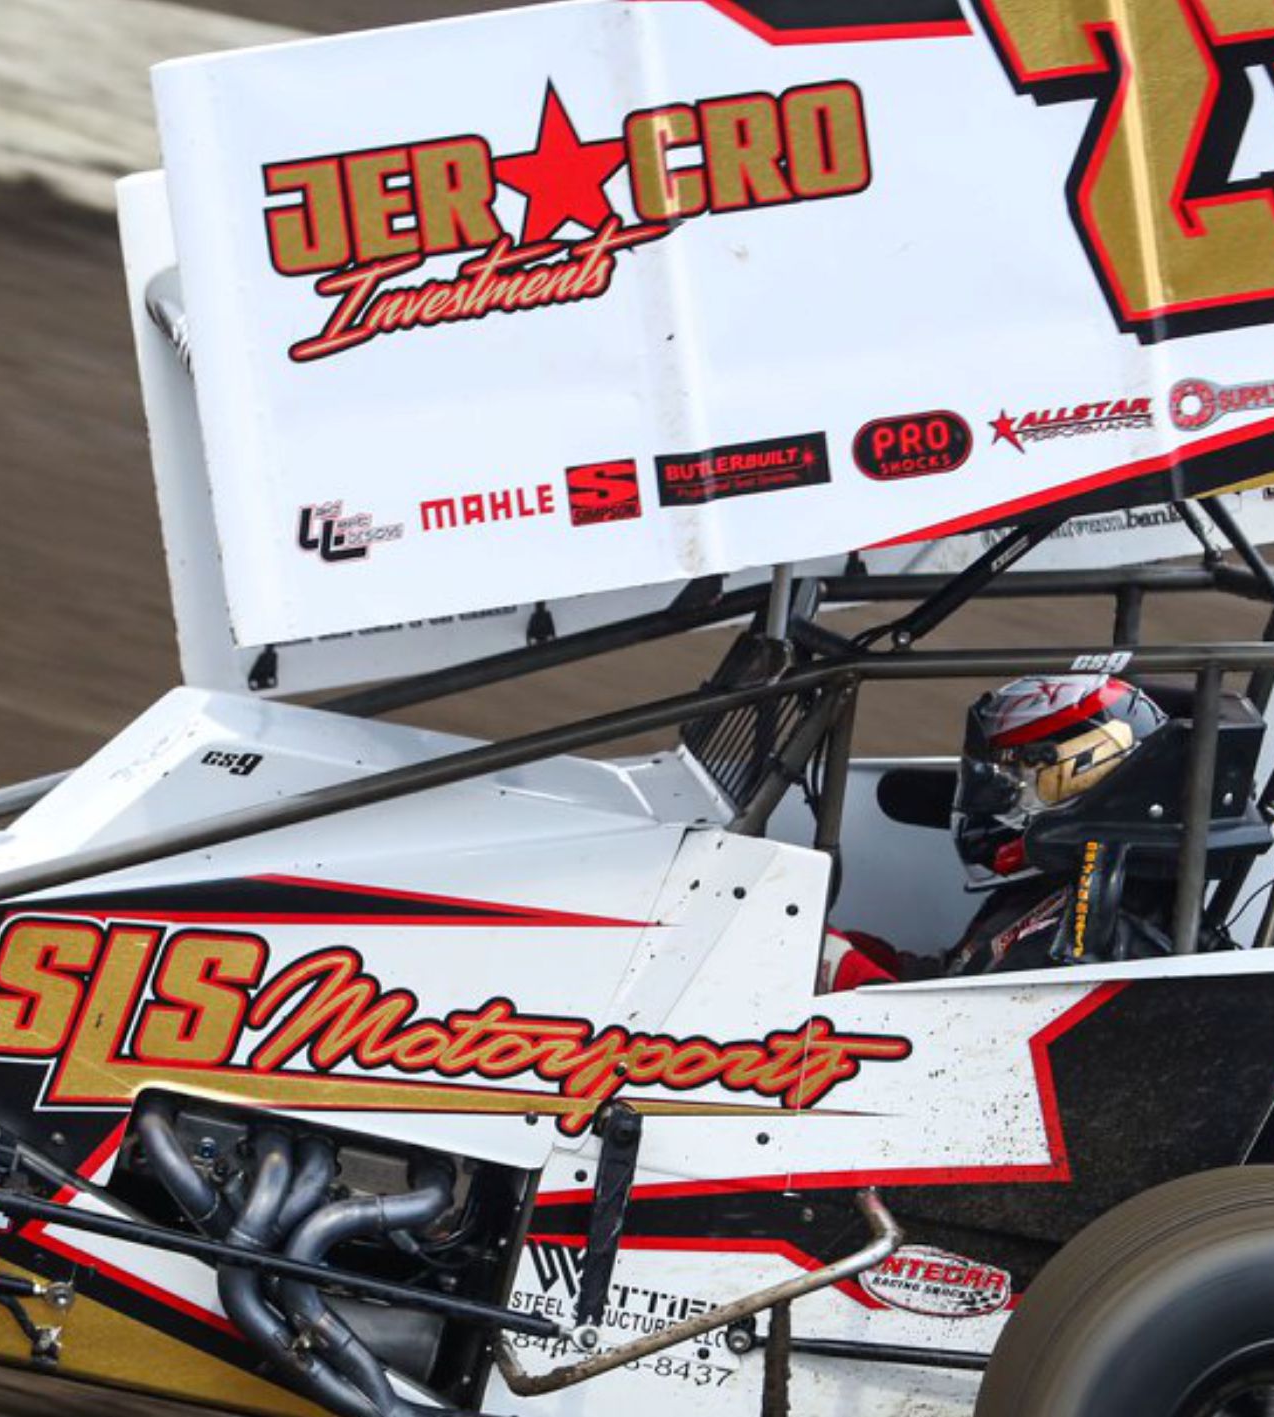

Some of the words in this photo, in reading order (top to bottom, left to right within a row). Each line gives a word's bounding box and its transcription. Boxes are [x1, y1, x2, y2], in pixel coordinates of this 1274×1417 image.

[262, 133, 505, 277] JER
[624, 80, 872, 222] CRO
[289, 216, 683, 363] Investments
[1017, 397, 1154, 430] ALLSTAR
[873, 420, 951, 460] PRO
[880, 451, 953, 476] SHOCKS
[420, 484, 556, 532] MAHLE
[250, 943, 913, 1134] Motorsports
[880, 1255, 1006, 1291] NTEGRA
[512, 1290, 566, 1319] STEEL
